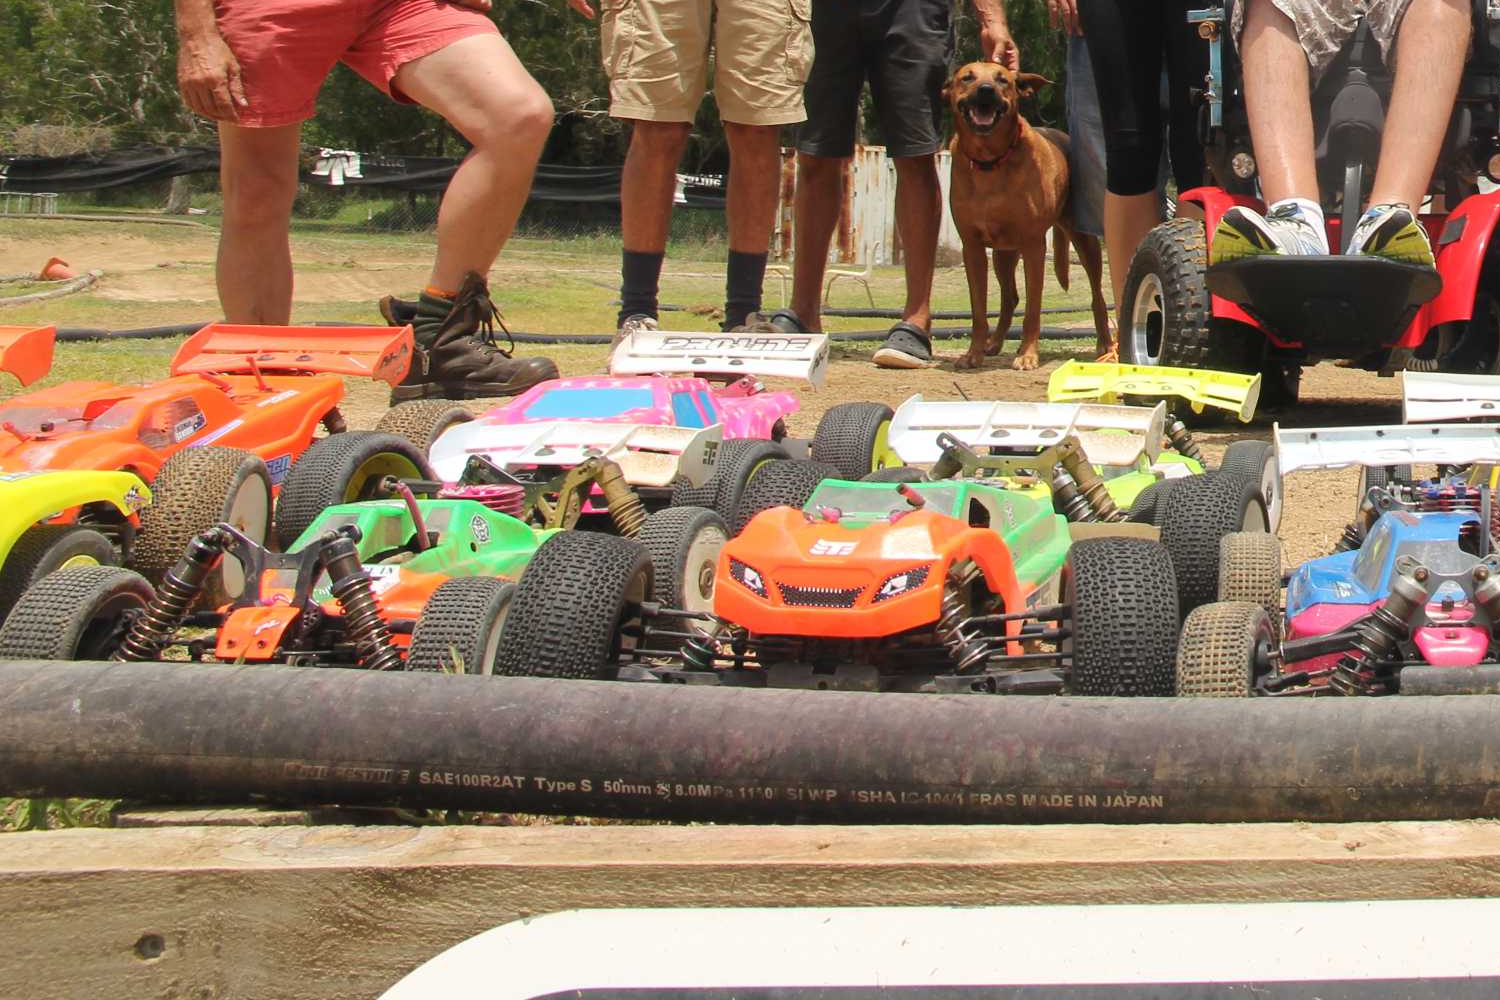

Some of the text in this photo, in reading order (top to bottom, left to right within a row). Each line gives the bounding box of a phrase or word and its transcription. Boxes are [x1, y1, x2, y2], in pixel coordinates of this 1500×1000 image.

[419, 771, 525, 789] SAE100R2AT
[534, 777, 576, 793] Type
[580, 779, 592, 792] S
[603, 779, 651, 794] 50mm
[853, 790, 896, 803] SHA
[1022, 794, 1073, 807] MADE
[1078, 795, 1097, 807] IN
[1103, 794, 1164, 808] JAPAN
